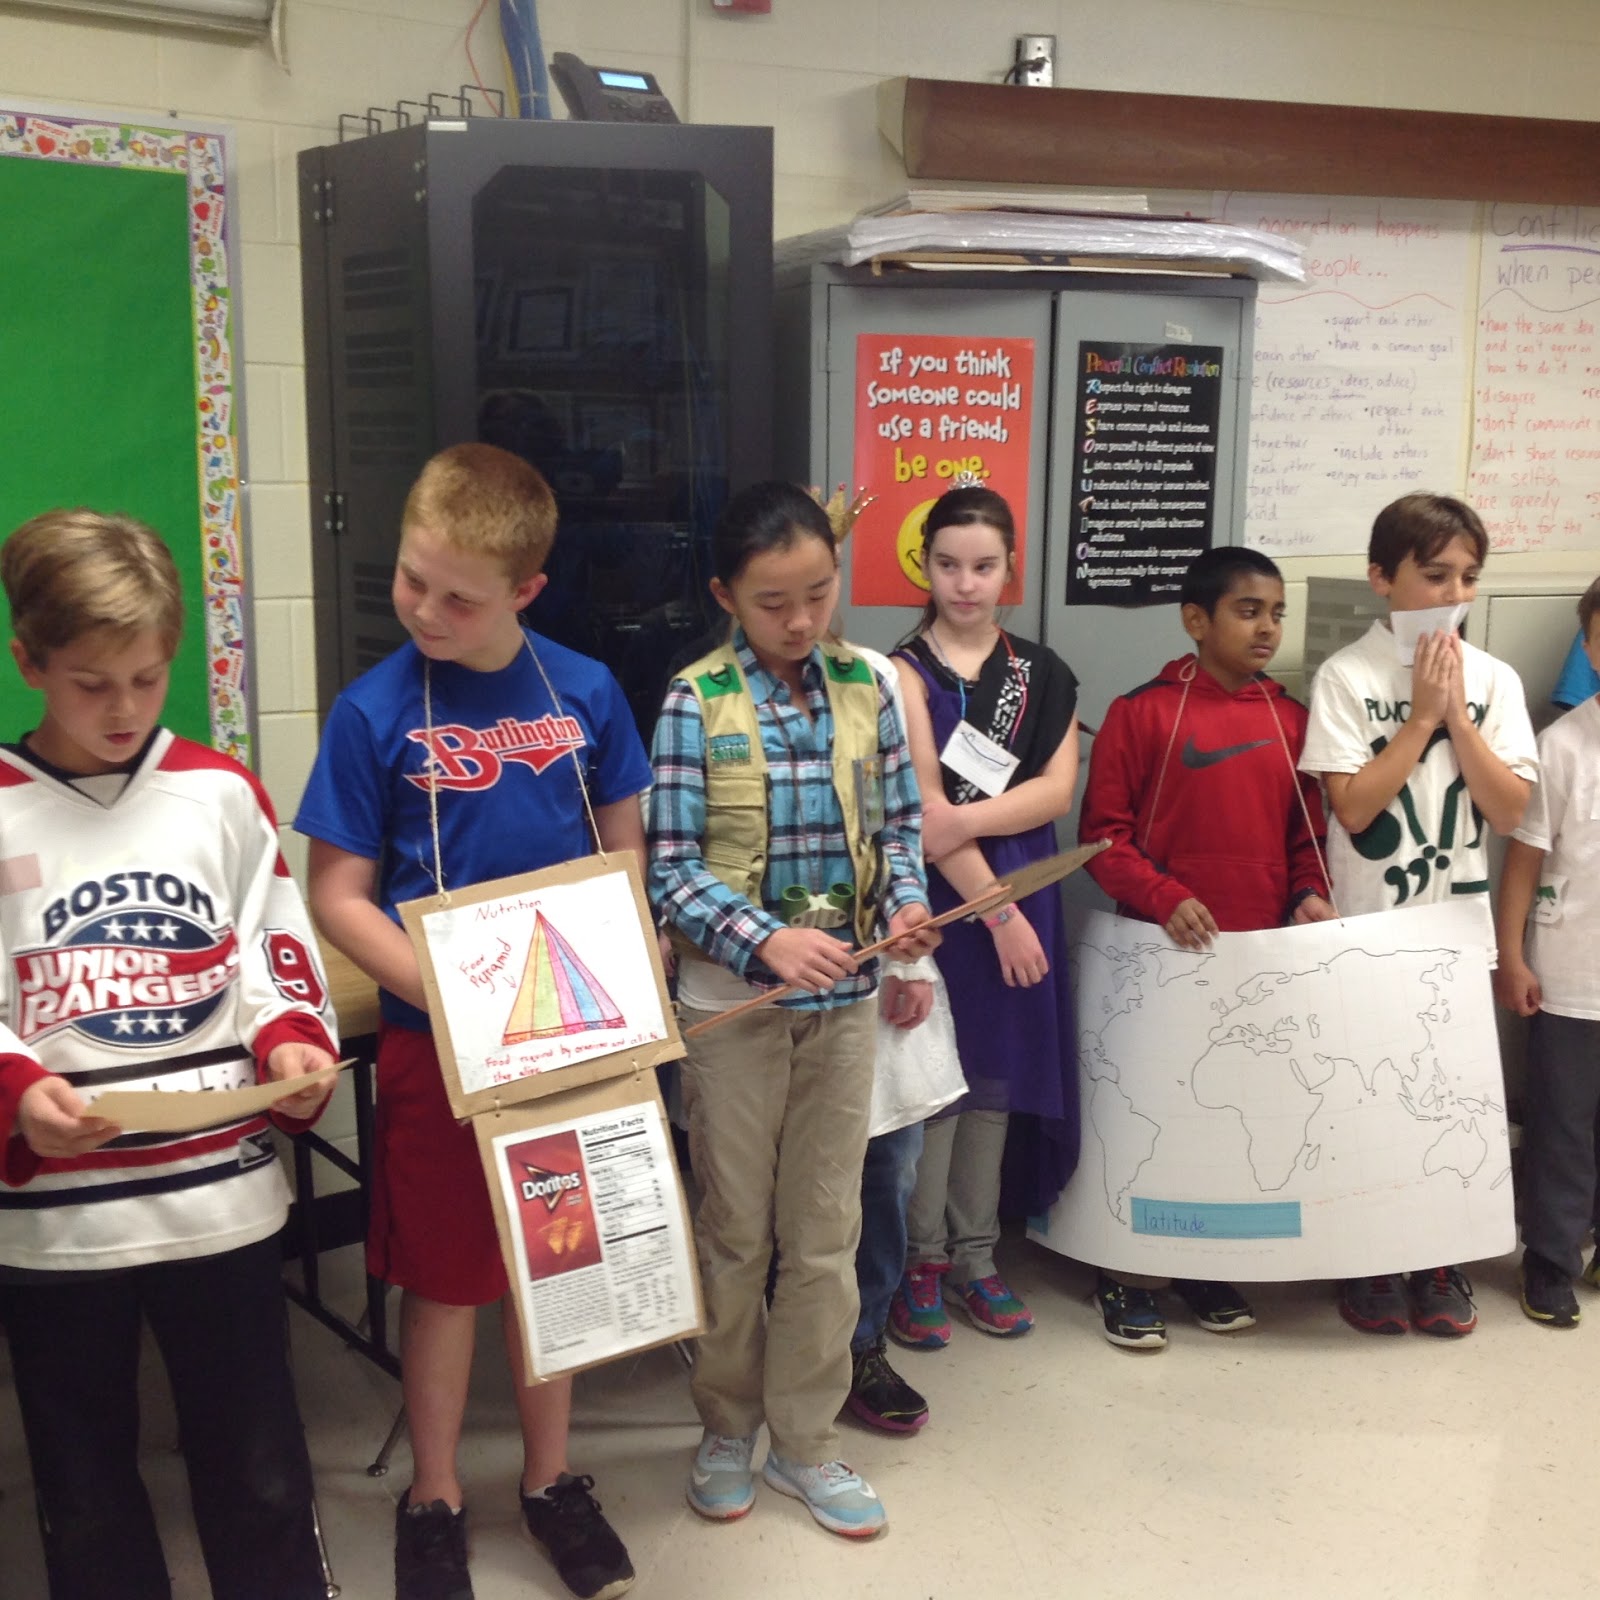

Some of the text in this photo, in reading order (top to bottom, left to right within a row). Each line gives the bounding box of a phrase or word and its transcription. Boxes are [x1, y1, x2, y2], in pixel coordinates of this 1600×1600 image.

[880, 348, 1011, 378] If you think
[966, 382, 1021, 410] could
[878, 414, 912, 441] use
[919, 418, 932, 438] a
[894, 448, 928, 482] be
[404, 714, 586, 792] Burlington
[44, 871, 216, 940] BOSTON
[475, 900, 542, 921] Nutrition
[22, 948, 170, 994] JUNIOR
[459, 954, 485, 976] Food
[470, 936, 512, 994] Pyramid
[485, 1055, 510, 1068] Food
[560, 1044, 571, 1058] by
[582, 1118, 645, 1137] Nutrition Facts
[522, 1172, 582, 1200] Doritos
[1144, 1206, 1208, 1232] latitude
